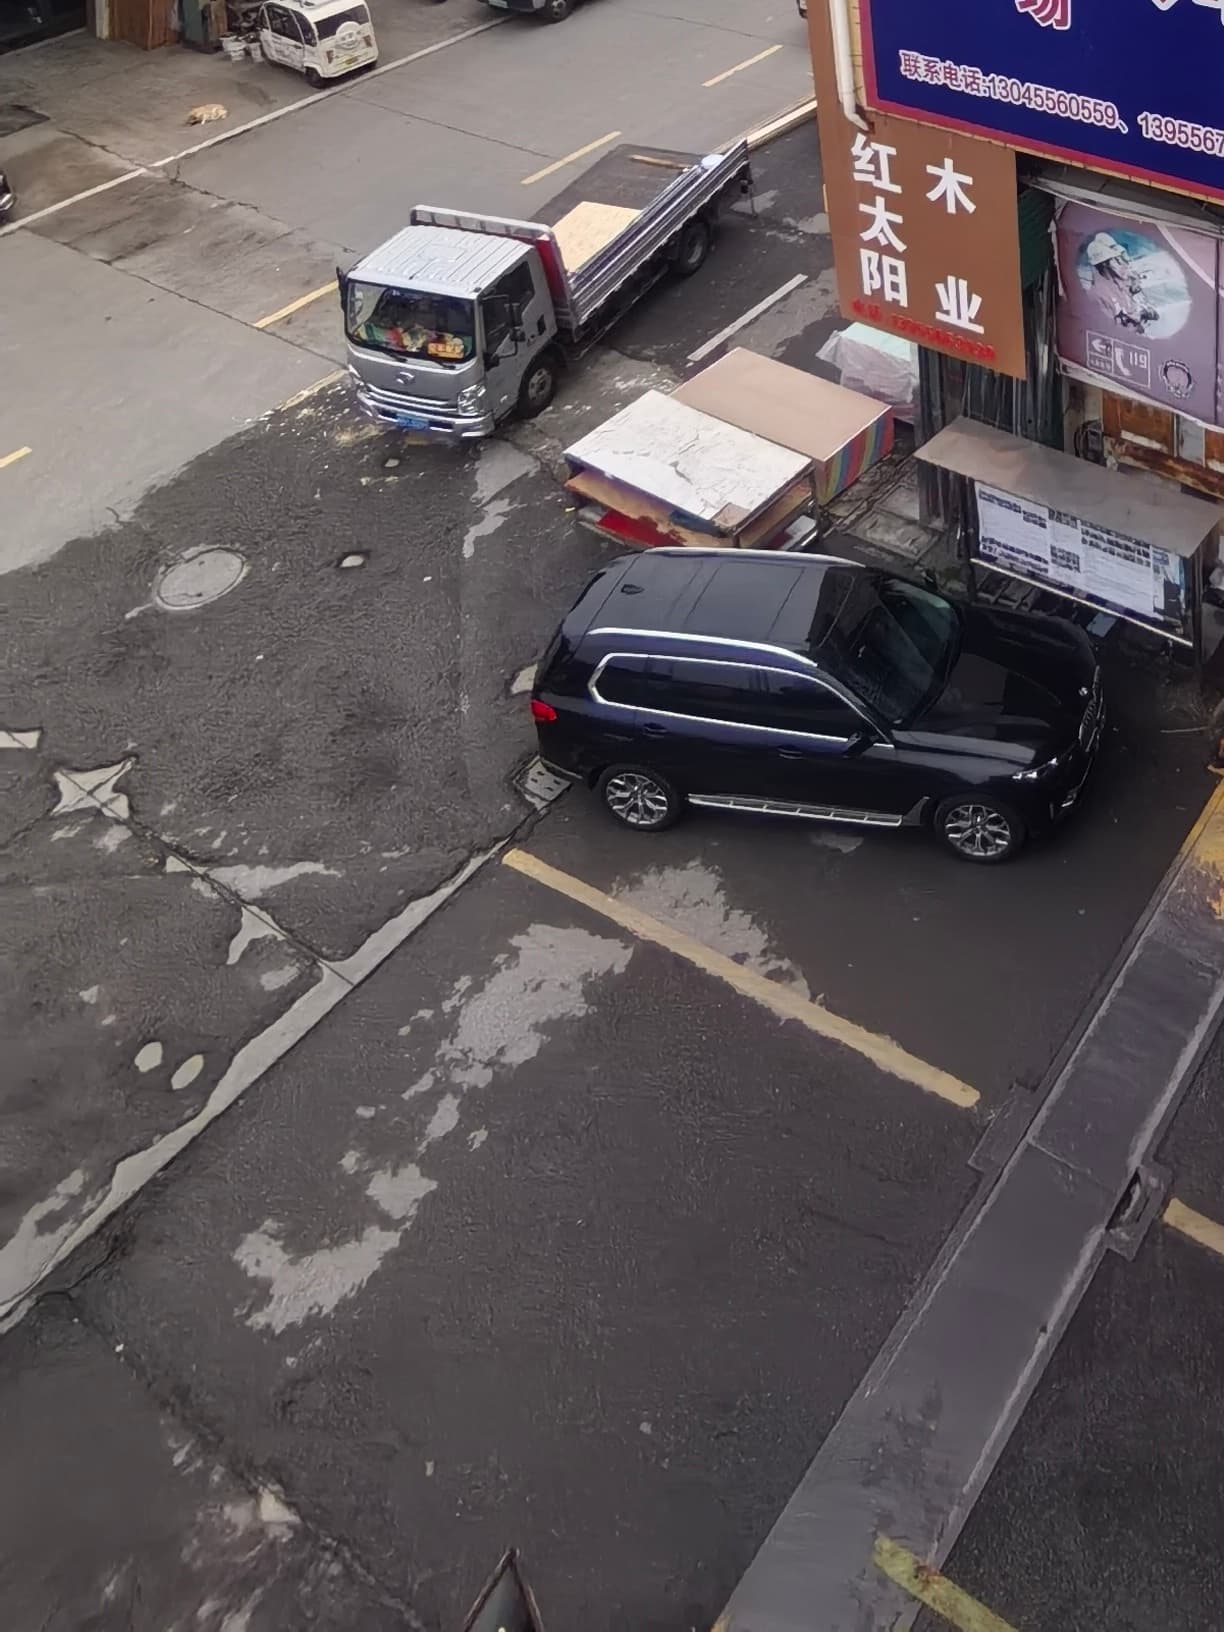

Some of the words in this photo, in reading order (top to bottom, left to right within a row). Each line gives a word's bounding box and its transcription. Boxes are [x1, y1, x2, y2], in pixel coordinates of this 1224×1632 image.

[850, 132, 909, 309] 红太阳
[925, 157, 985, 335] 木业
[1129, 351, 1147, 369] 119
